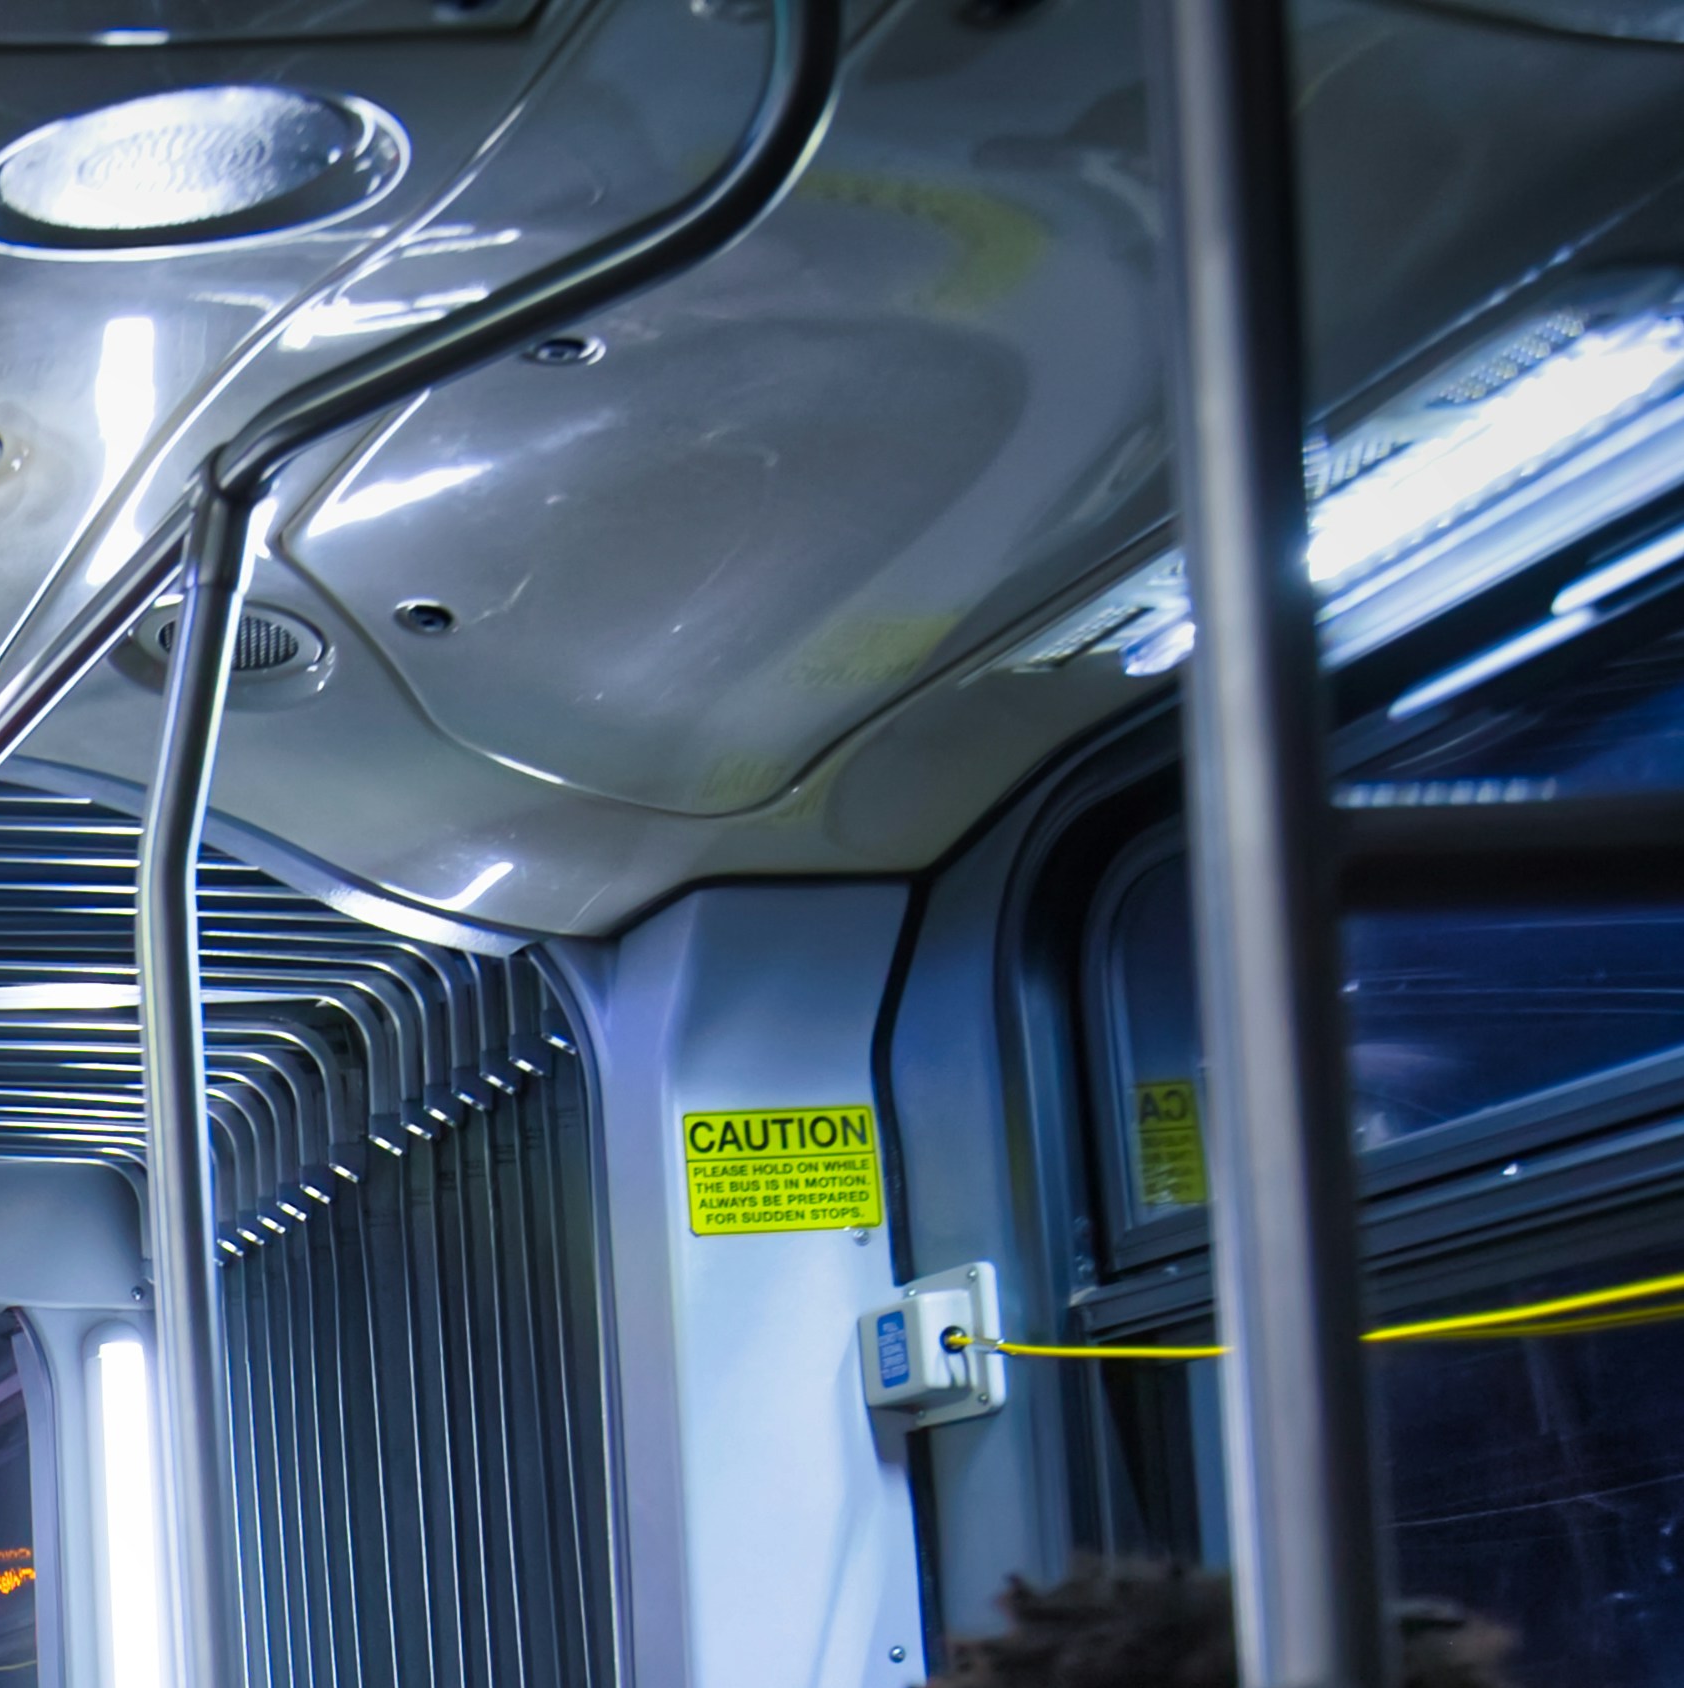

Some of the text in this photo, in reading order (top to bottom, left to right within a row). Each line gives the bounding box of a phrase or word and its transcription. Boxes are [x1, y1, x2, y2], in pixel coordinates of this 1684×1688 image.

[689, 1114, 868, 1153] CAUTION
[693, 1158, 870, 1178] PLEASE HOLD ON WHILE
[695, 1175, 871, 1194] THE BUS IS IN MOTION.
[699, 1190, 870, 1210] ALWAYS BE PREPARED
[706, 1206, 864, 1225] FOR SUDDEN STOPS.
